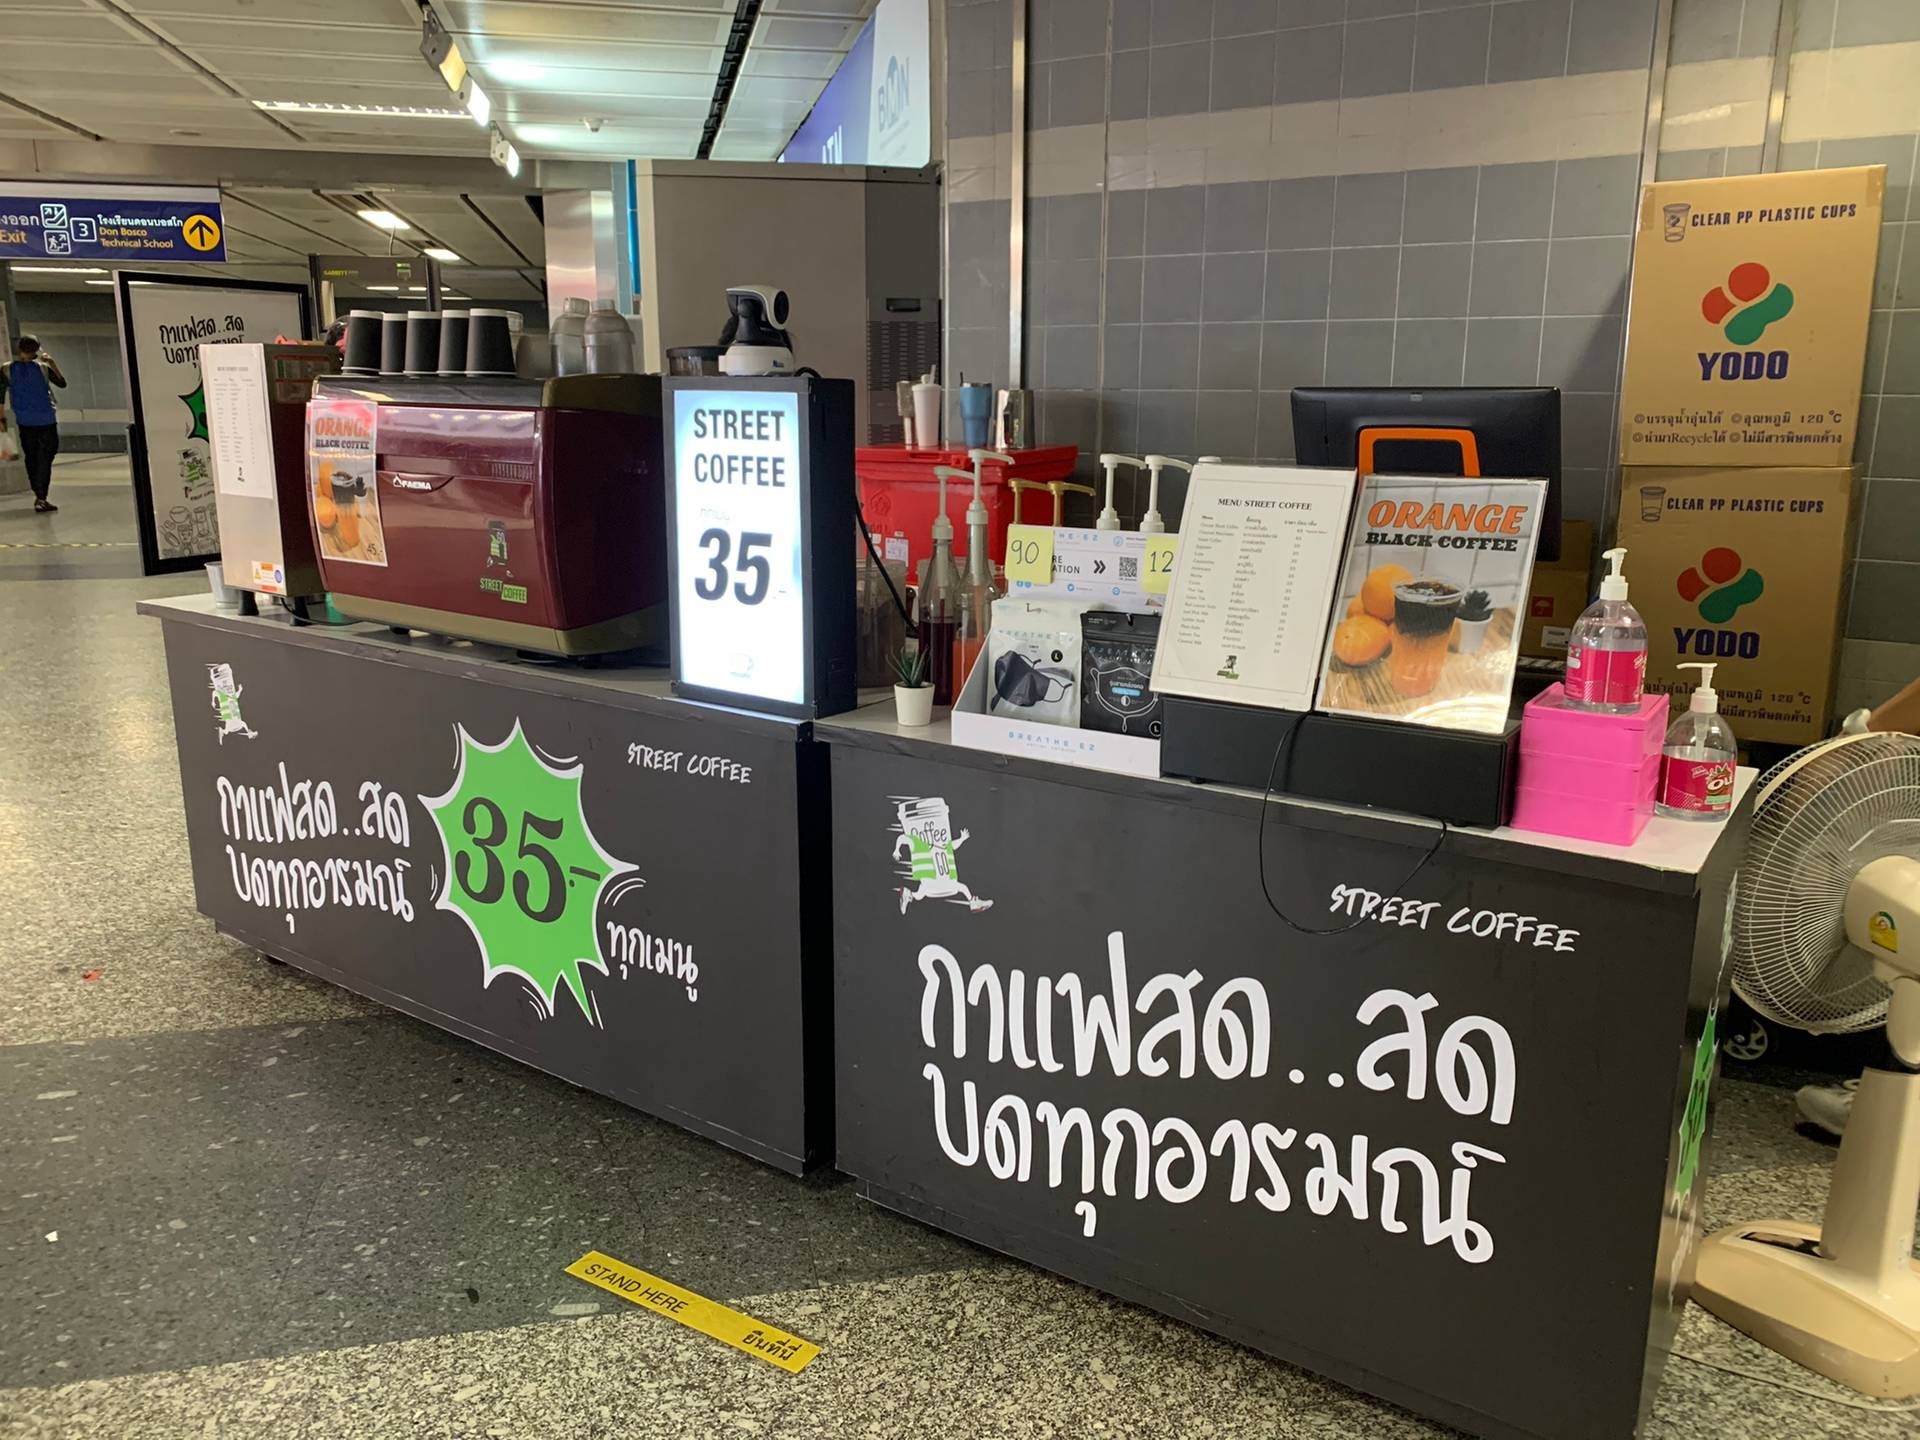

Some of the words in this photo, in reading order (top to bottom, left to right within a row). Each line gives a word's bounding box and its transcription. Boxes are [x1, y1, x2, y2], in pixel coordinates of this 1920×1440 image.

[1692, 212, 1731, 227] CLEAR
[1736, 211, 1753, 224] PP
[1759, 205, 1816, 223] PLASTIC
[1821, 203, 1857, 219] CUPS
[0, 229, 27, 243] Exit
[79, 223, 89, 237] 3
[100, 227, 119, 236] Don
[121, 228, 148, 236] Bosco
[101, 239, 142, 248] Technical
[143, 240, 174, 249] School
[1697, 350, 1790, 381] YODO
[694, 408, 786, 442] STREET
[1799, 414, 1824, 424] 120
[315, 439, 340, 449] BLACK
[341, 440, 370, 450] COFFEE
[694, 453, 786, 487] COFFEE
[402, 480, 432, 490] FAEMA
[1218, 498, 1242, 507] MENU
[1244, 500, 1277, 509] STREET
[1278, 502, 1313, 511] COFFEE
[1667, 497, 1704, 511] CLEAR
[1709, 499, 1725, 511] PP
[1731, 499, 1784, 513] PLASTIC
[1790, 500, 1824, 514] CUPS
[1367, 499, 1529, 535] ORANGE
[1010, 539, 1040, 565] 90
[1365, 532, 1432, 548] BLACK
[1437, 536, 1518, 552] COFFEE
[1052, 565, 1080, 574] ATION
[1673, 627, 1761, 660] YODO
[1771, 692, 1794, 704] 120
[627, 742, 684, 774] STREET
[687, 754, 752, 784] COFFEE
[1329, 883, 1441, 931] STREET
[1447, 907, 1581, 953] COFFEE
[606, 920, 699, 1003] ทุกเมนู
[584, 1263, 642, 1293] STAND
[639, 1286, 689, 1315] HERE
